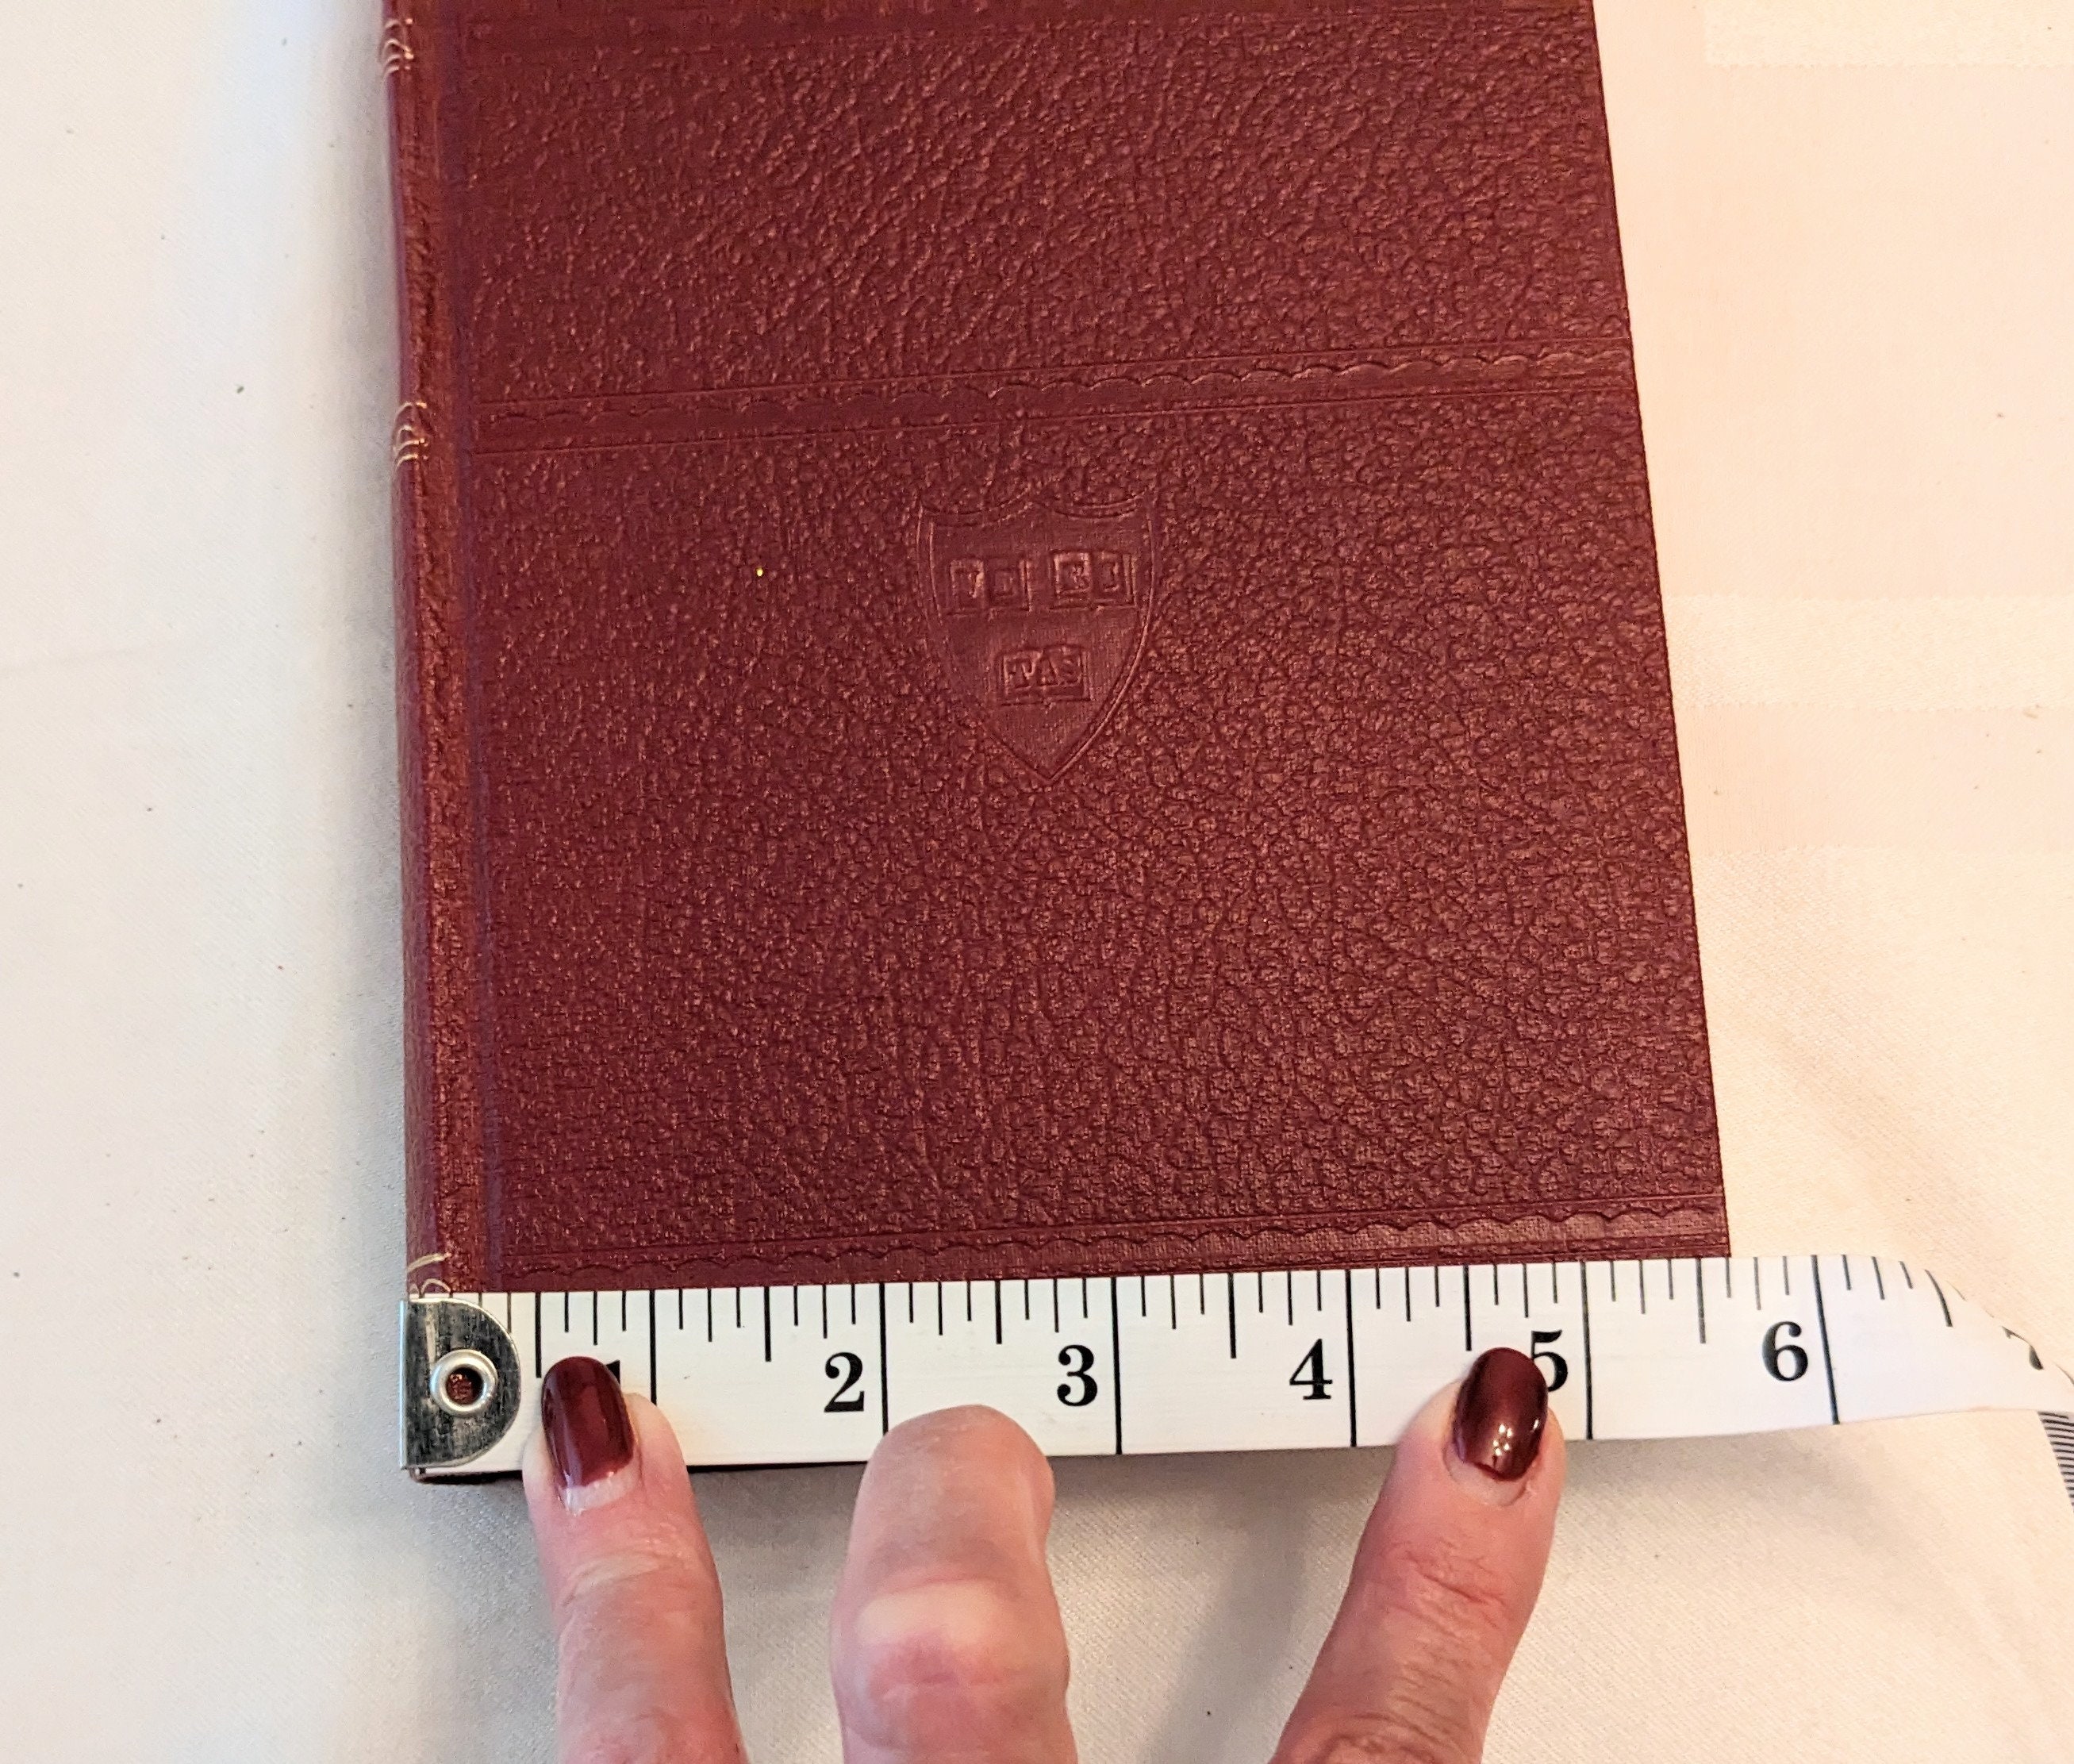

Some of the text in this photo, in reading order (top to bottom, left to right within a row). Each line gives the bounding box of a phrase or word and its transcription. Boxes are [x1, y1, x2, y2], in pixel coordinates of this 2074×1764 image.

[824, 1351, 866, 1413] 2
[1056, 1344, 1098, 1407] 3
[1289, 1338, 1333, 1401] 4
[1531, 1329, 1568, 1392] 5
[1762, 1321, 1809, 1382] 6
